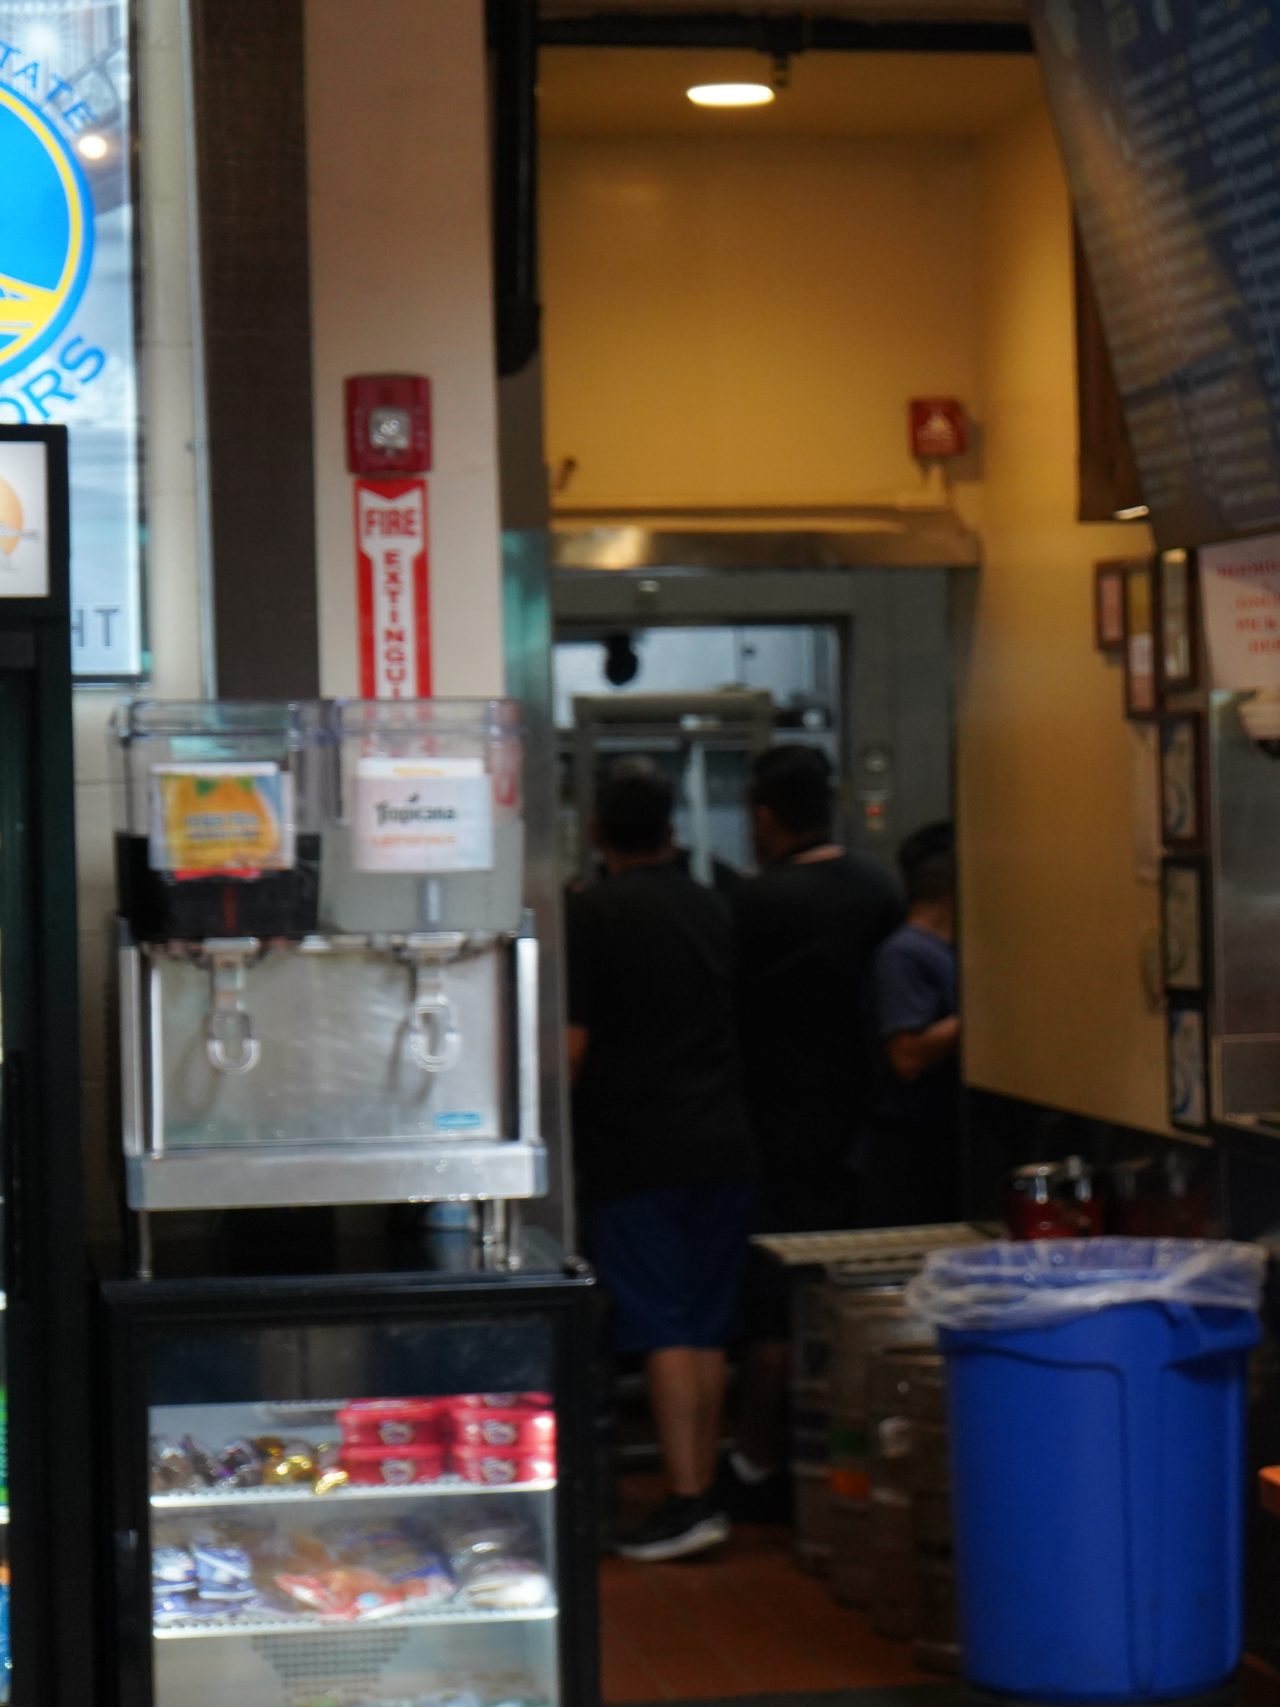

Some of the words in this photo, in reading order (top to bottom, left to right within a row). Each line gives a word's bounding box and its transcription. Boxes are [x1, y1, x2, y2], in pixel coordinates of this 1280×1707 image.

[0, 335, 107, 426] RS
[365, 508, 417, 537] FIRE
[375, 801, 456, 826] Tropicana
